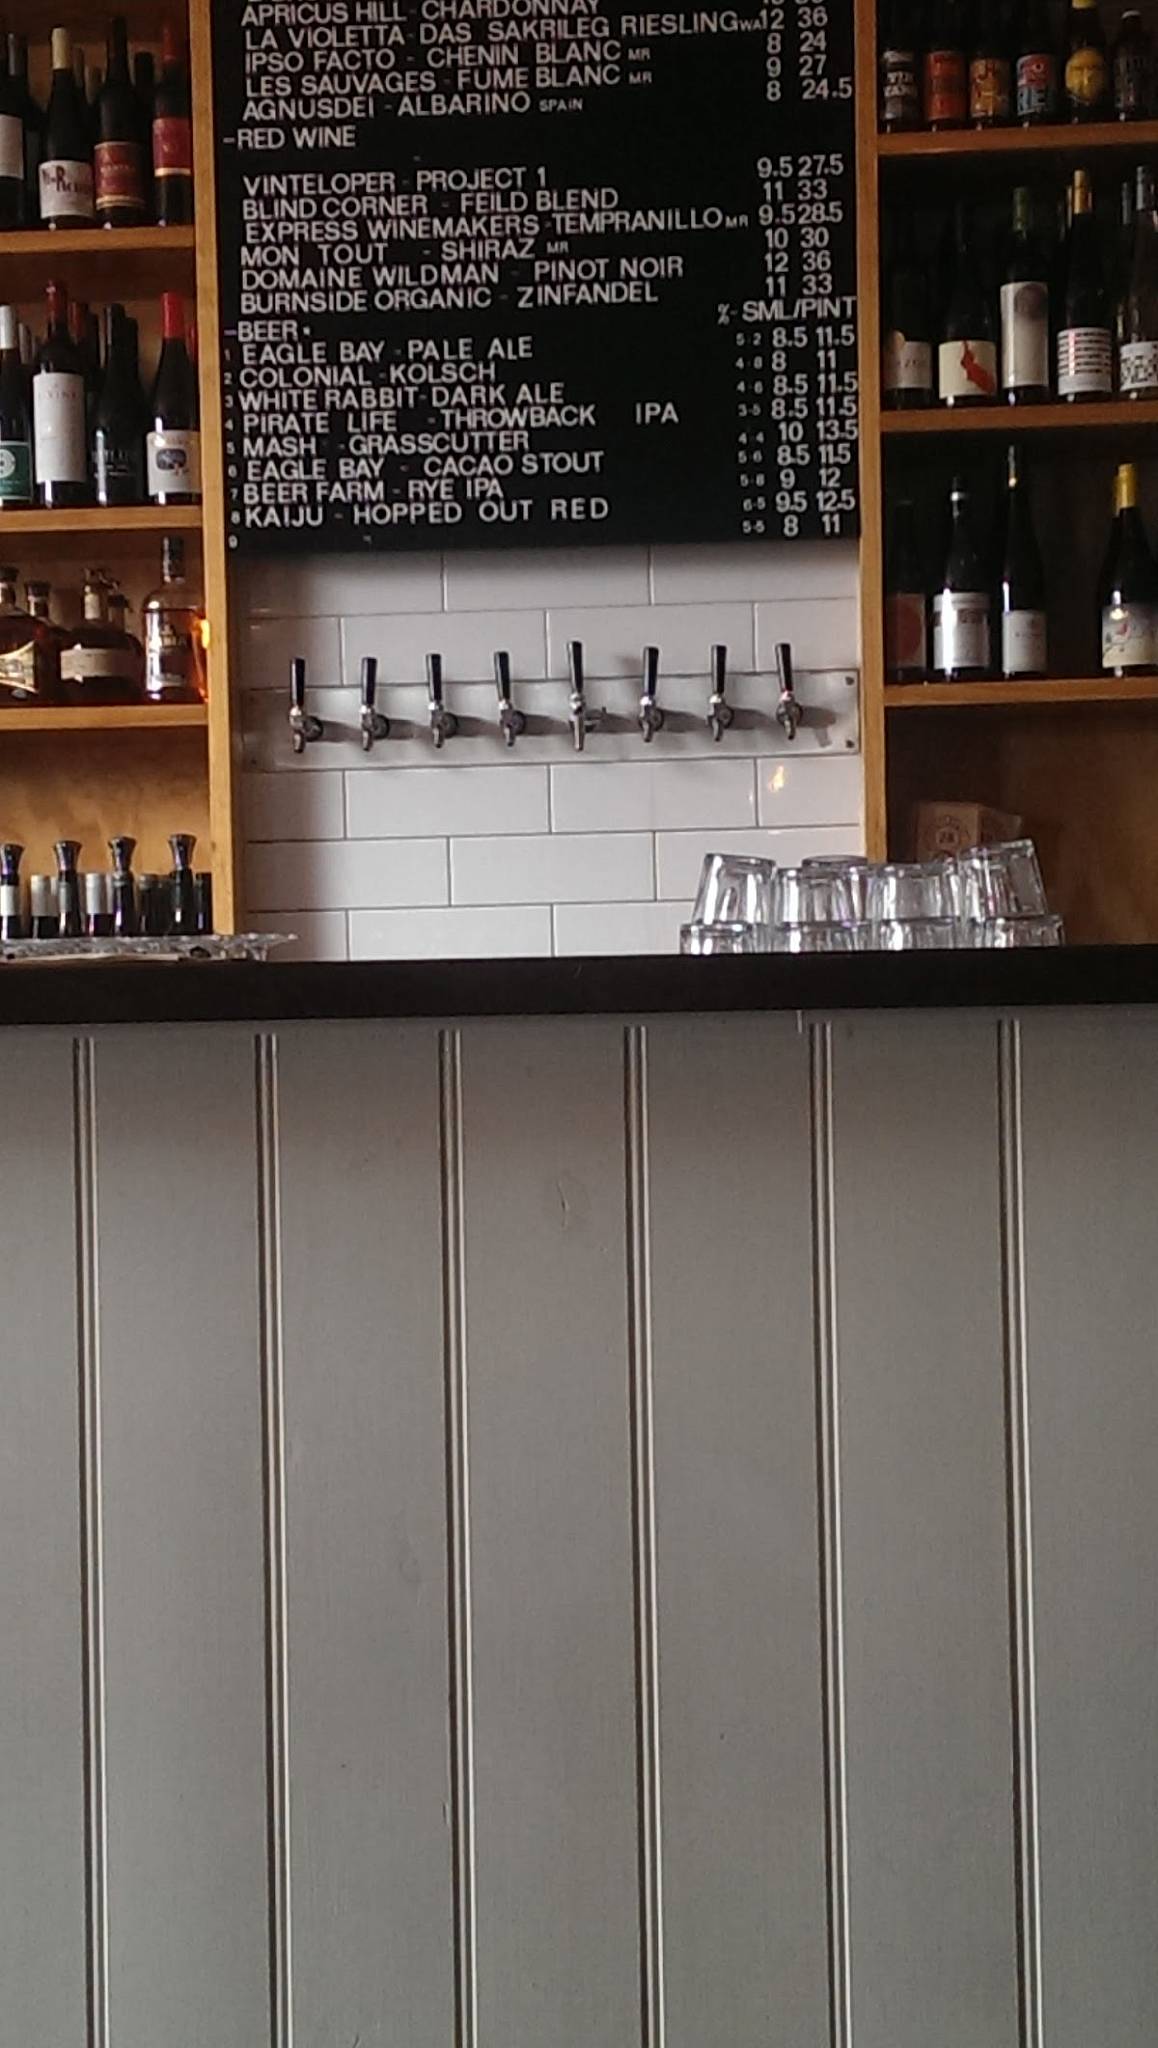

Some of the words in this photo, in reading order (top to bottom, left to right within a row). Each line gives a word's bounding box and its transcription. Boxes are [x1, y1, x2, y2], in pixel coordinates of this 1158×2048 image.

[240, 2, 349, 26] APRICUS
[355, 1, 407, 22] HILL
[422, 0, 598, 20] CHARDONNAY
[246, 29, 278, 50] LA
[288, 25, 405, 48] VIOLETTA
[420, 22, 471, 44] DAS
[488, 17, 609, 42] SAKRILEG
[621, 11, 738, 35] RIESLING
[798, 7, 828, 28] 36
[246, 51, 304, 73] IPSO
[314, 48, 395, 71] FACTO
[427, 44, 518, 68] CHENIN
[536, 40, 620, 63] BLANC
[767, 33, 781, 53] 8
[800, 31, 826, 52] 24
[246, 76, 291, 97] LES
[301, 71, 436, 95] SAUVAGES
[458, 68, 528, 90] FUME
[536, 64, 619, 87] BLANC
[767, 57, 781, 77] 9
[800, 55, 826, 76] 27
[243, 96, 374, 121] AGNUSDEI
[398, 91, 530, 116] ALBARINO
[539, 98, 583, 112] SPAIN
[767, 81, 781, 101] 8
[803, 78, 852, 99] 24.5
[293, 125, 355, 148] WINE
[243, 172, 395, 196] VINTELOPER
[417, 167, 526, 191] PROJECT
[538, 167, 545, 186] 1
[757, 156, 793, 178] 9.5
[799, 154, 843, 176] 27.5
[243, 198, 317, 220] BLIND
[322, 194, 427, 218] CORNER
[461, 192, 528, 213] FEILD
[536, 188, 618, 211] BLEND
[764, 181, 782, 201] 11
[798, 179, 827, 200] 33
[246, 220, 358, 243] EXPRESS
[367, 214, 539, 240] WINEMAKERS
[552, 207, 722, 234] TEMPRANILLO
[759, 204, 795, 225] 9.5
[798, 202, 842, 224] 28.5
[241, 245, 299, 267] MON
[318, 243, 388, 265] TOUT
[441, 238, 534, 261] SHIRAZ
[765, 228, 788, 248] 10
[801, 227, 829, 248] 30
[242, 267, 361, 291] DOMAINE
[372, 263, 498, 287] WILDMAN
[535, 259, 609, 281] PINOT
[620, 256, 683, 278] NOIR
[765, 252, 788, 272] 12
[803, 250, 831, 271] 36
[241, 290, 367, 314] BURNSIDE
[374, 287, 491, 310] ORGANIC
[517, 281, 658, 308] ZINFANDEL
[766, 276, 785, 296] 11
[803, 273, 832, 295] 33
[243, 342, 326, 365] EAGLE
[340, 341, 384, 363] BAY
[408, 338, 472, 360] PALE
[488, 336, 532, 360] ALE
[773, 327, 808, 347] 8.5
[816, 325, 855, 346] 11.5
[240, 365, 372, 389] COLONIAL
[390, 362, 495, 384] KOLSCH
[772, 351, 786, 371] 8
[817, 350, 836, 369] 11
[238, 389, 317, 412] WHITE
[325, 386, 418, 410] RABBIT
[432, 384, 505, 407] DARK
[516, 382, 563, 404] ALE
[773, 374, 808, 395] 8.5
[817, 371, 858, 393] 11.5
[243, 412, 329, 434] PIRATE
[347, 410, 396, 433] LIFE
[440, 405, 595, 430] THROWBACK
[636, 403, 678, 423] IPA
[771, 398, 808, 419] 8.5
[816, 395, 857, 416] 11.5
[243, 436, 316, 458] MASH
[349, 430, 529, 455] GRASSCUTTER
[779, 421, 803, 442] 10
[816, 419, 858, 441] 13.5
[247, 459, 326, 481] EAGLE
[339, 457, 384, 479] BAY
[424, 454, 513, 477] CACAO
[522, 451, 604, 474] STOUT
[777, 444, 810, 466] 8.5
[819, 443, 851, 464] 11.5
[243, 482, 308, 505] BEER
[316, 480, 384, 502] FARM
[408, 478, 453, 500] RYE
[466, 477, 504, 499] IPA
[780, 469, 795, 489] 9
[819, 467, 840, 488] 12
[245, 506, 323, 528] KAIJU
[354, 502, 462, 524] HOPPED
[479, 500, 532, 522] OUT
[551, 498, 608, 520] RED
[776, 491, 807, 512] 9.5
[816, 489, 855, 511] 12.5
[784, 515, 798, 536] 8
[822, 514, 840, 533] 11
